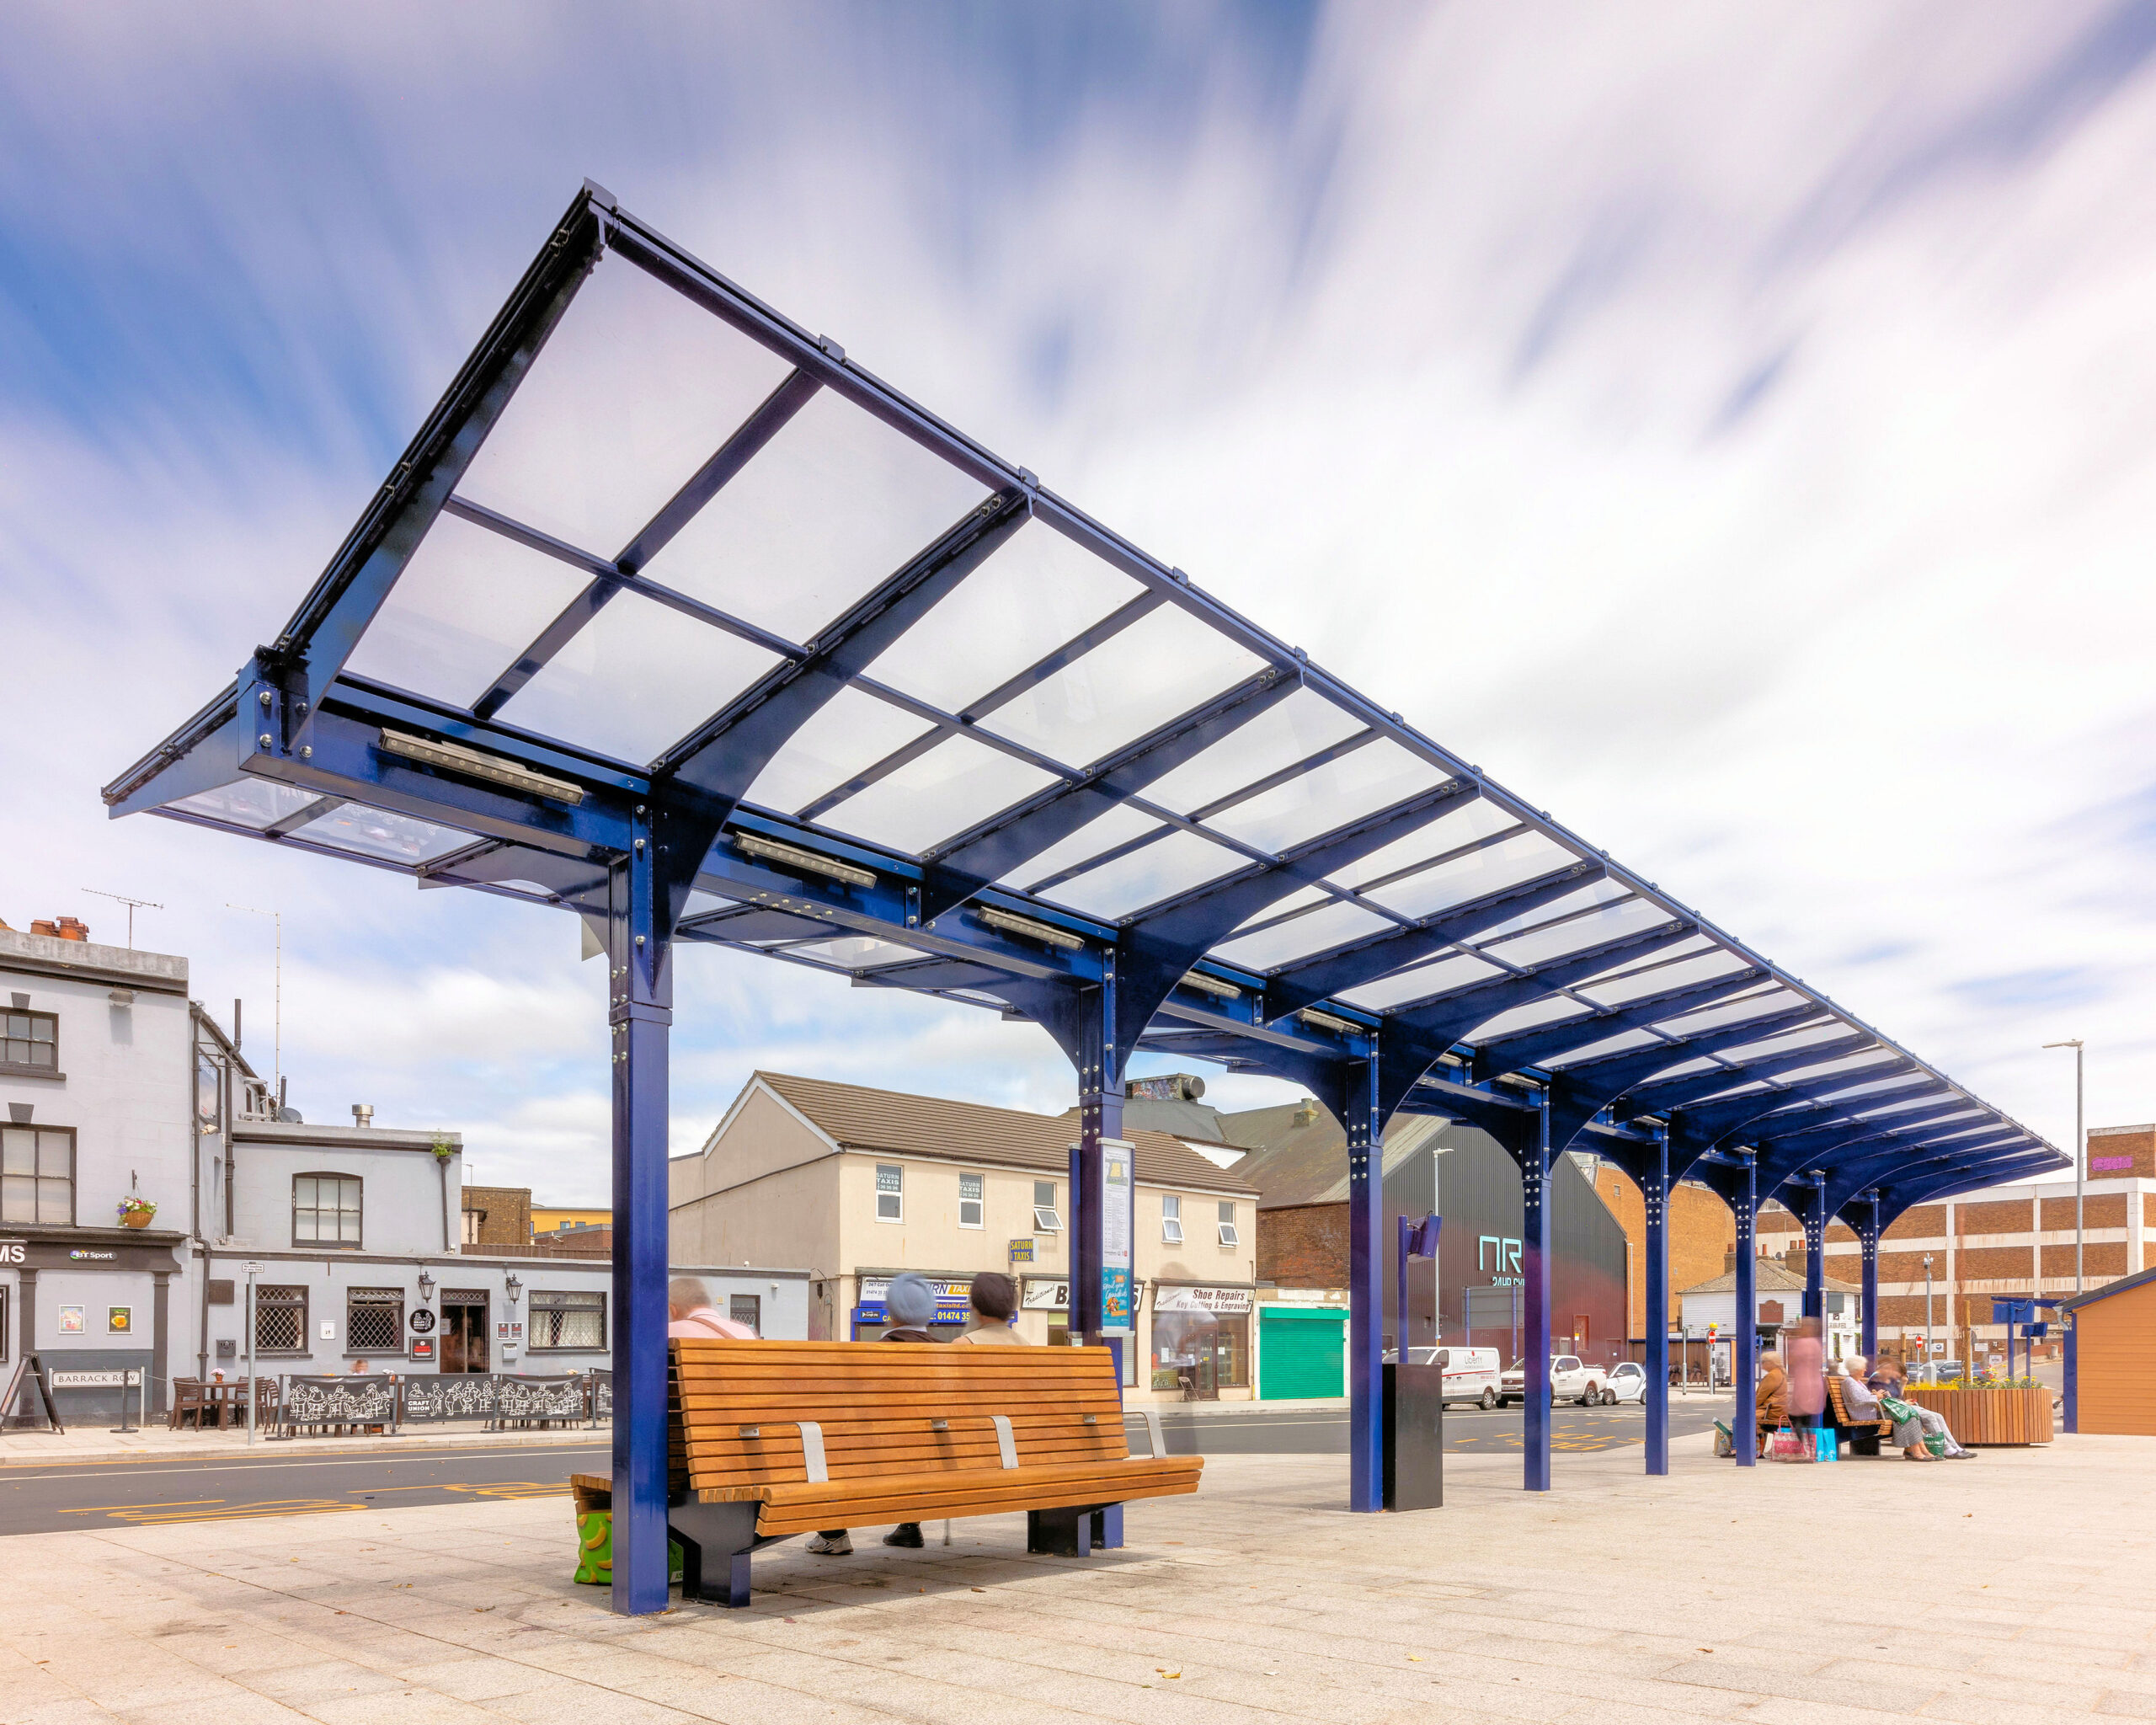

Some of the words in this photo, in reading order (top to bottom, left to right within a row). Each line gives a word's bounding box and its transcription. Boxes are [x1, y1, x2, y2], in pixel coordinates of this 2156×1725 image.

[1011, 1240, 1033, 1250] SATURN
[1014, 1252, 1030, 1261] TAXIS
[953, 1285, 970, 1294] TAXI
[1026, 1284, 1055, 1305] Traditional
[1193, 1289, 1213, 1300] Shoe
[1215, 1290, 1246, 1301] Repairs
[1177, 1300, 1188, 1310] Key
[1190, 1301, 1212, 1310] Cutting
[1221, 1302, 1251, 1311] Engraving
[938, 1311, 960, 1321] 01474
[58, 1375, 108, 1383] BARRACK
